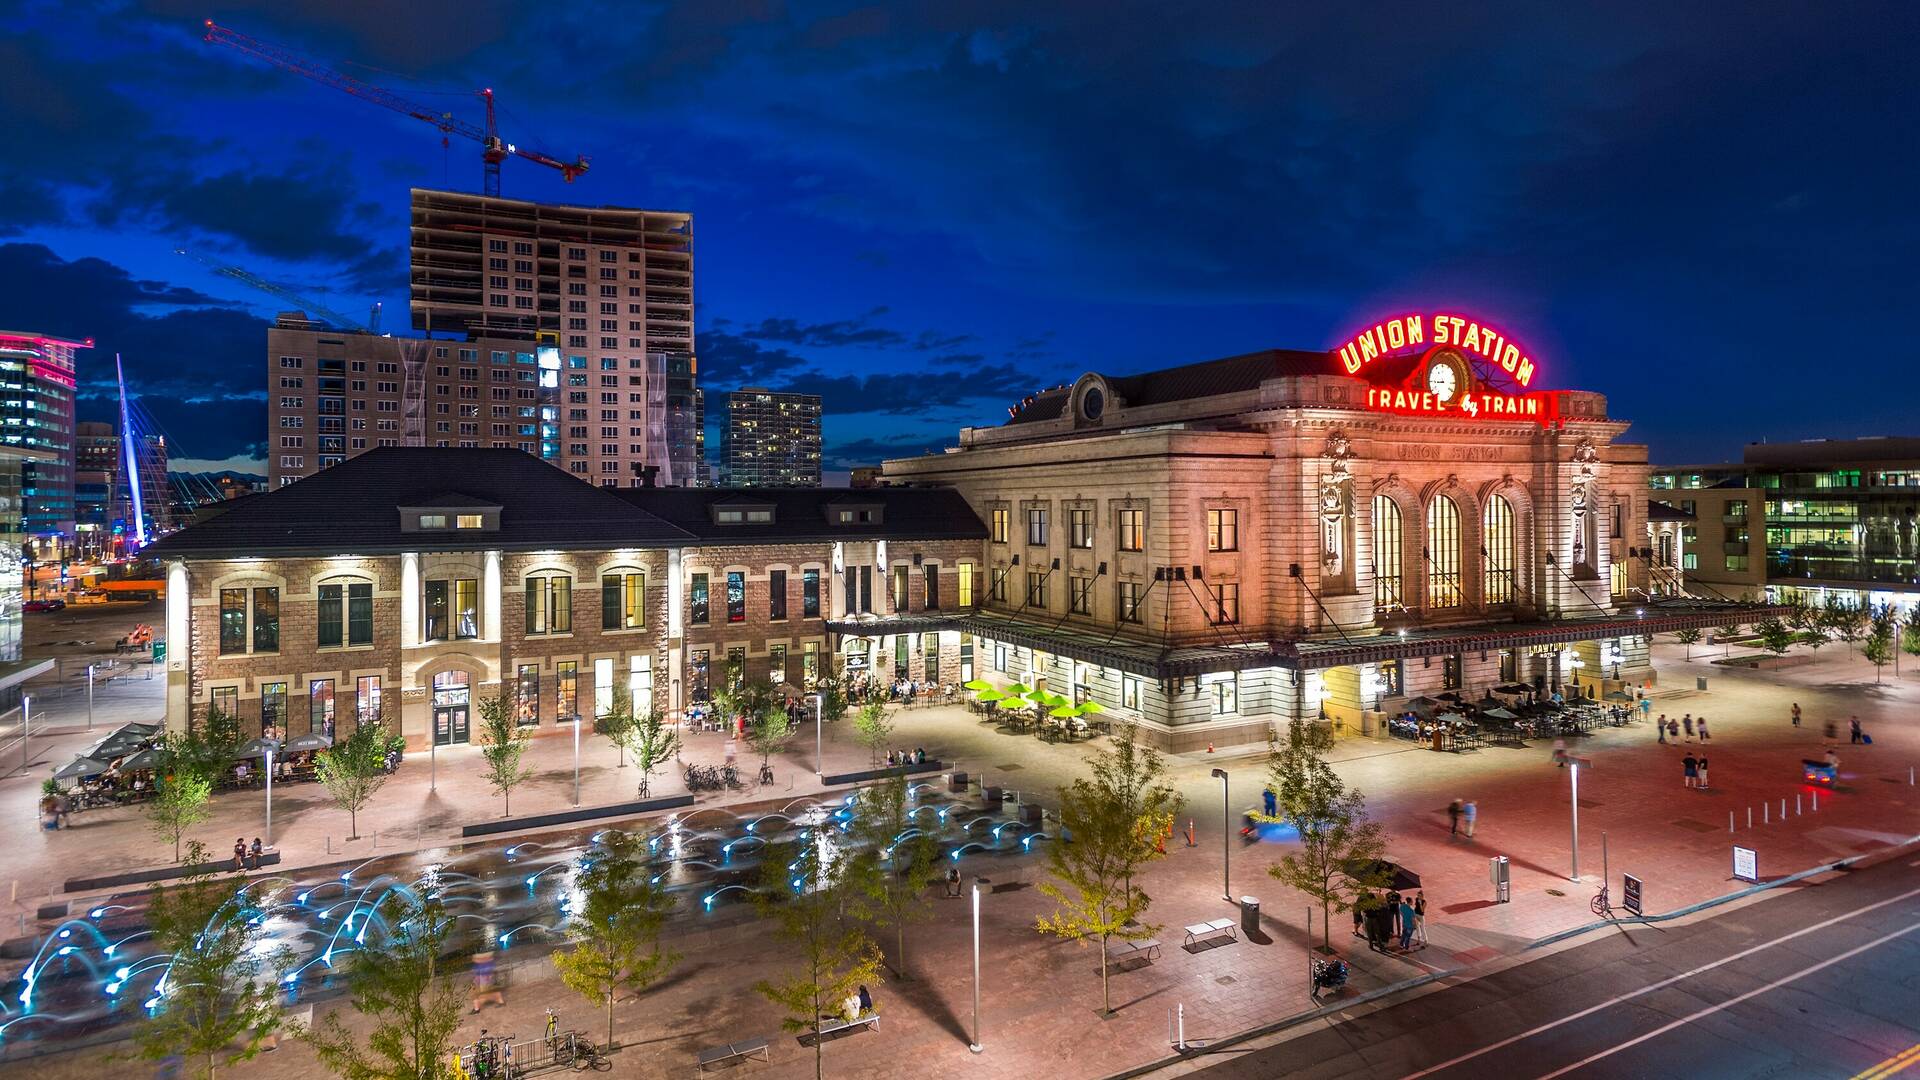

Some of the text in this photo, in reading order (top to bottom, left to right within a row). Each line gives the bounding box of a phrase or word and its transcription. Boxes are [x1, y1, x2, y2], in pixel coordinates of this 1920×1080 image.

[1339, 315, 1535, 387] UNION STATION
[1368, 389, 1537, 417] TRAVEL by TRAIN
[1397, 444, 1504, 460] UNION STATION
